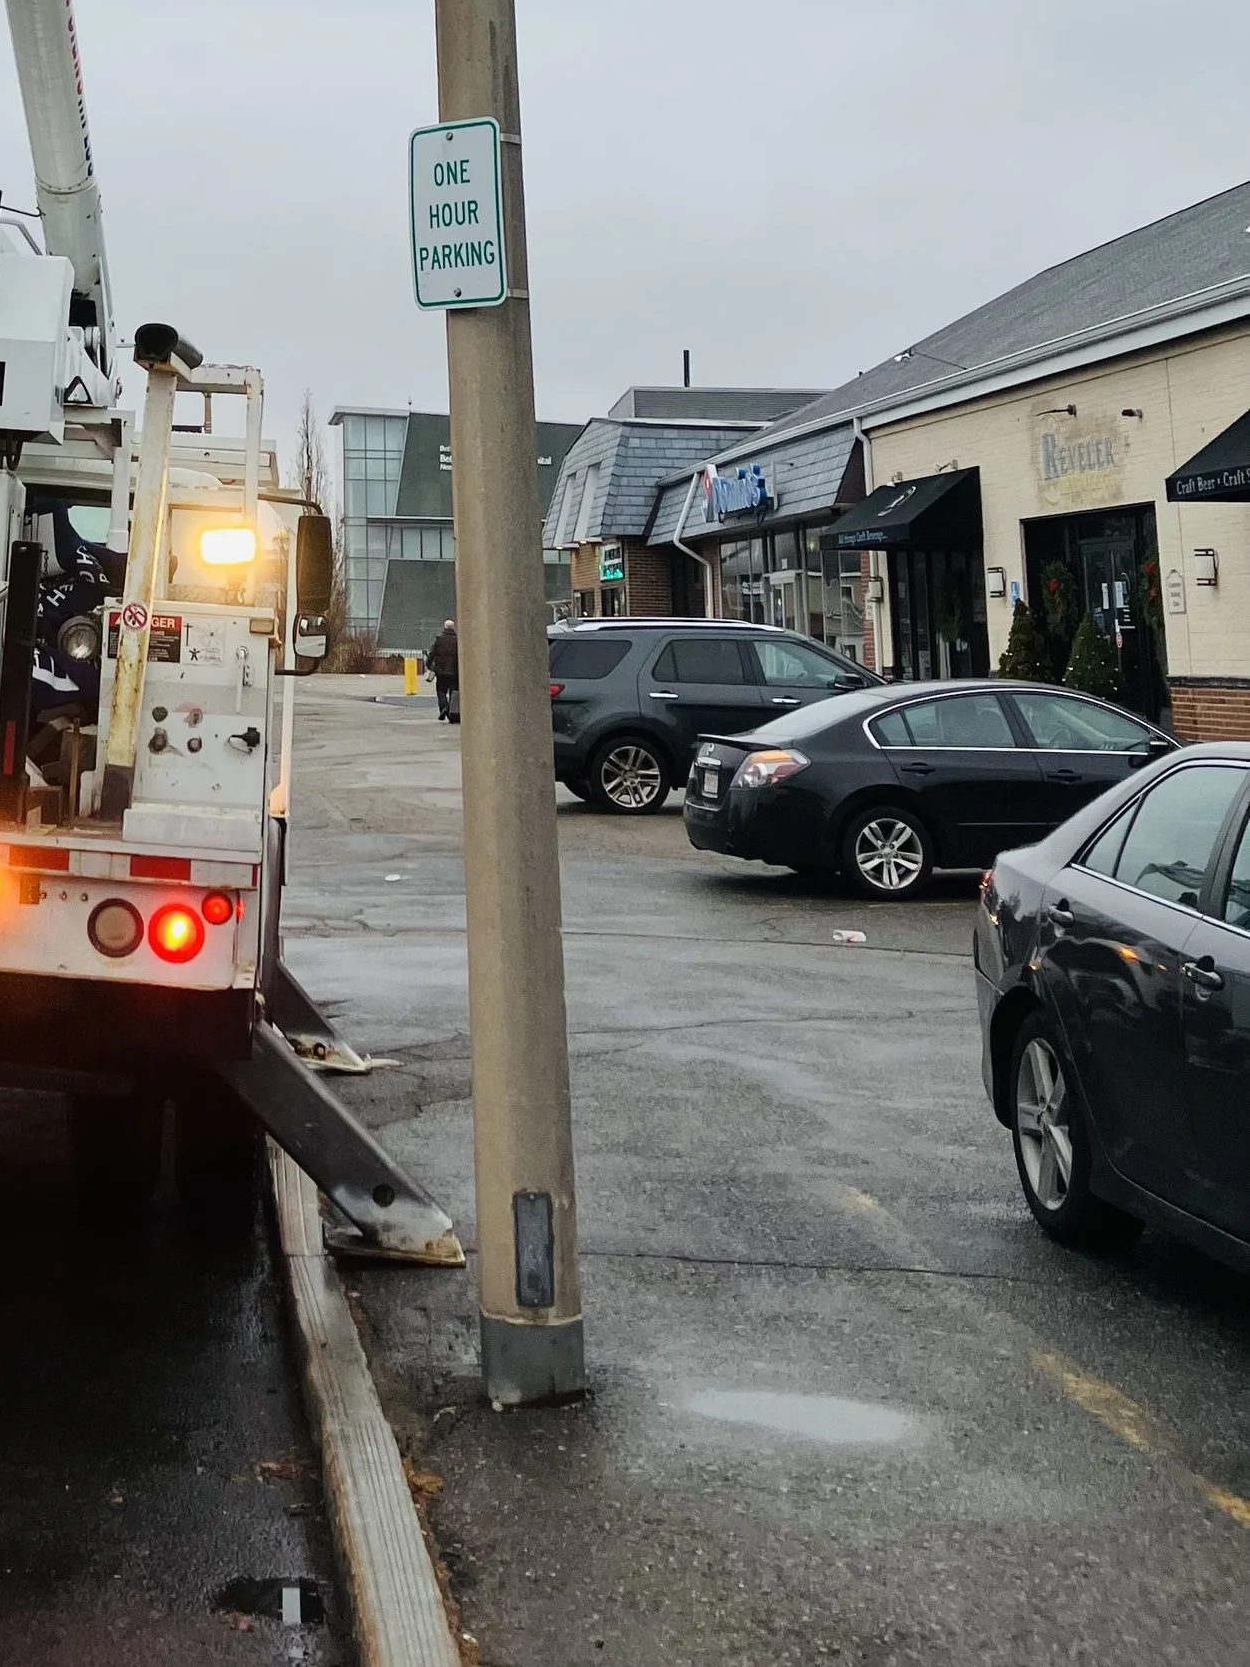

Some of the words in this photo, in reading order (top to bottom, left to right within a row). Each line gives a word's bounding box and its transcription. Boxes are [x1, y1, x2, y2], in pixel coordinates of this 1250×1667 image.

[434, 159, 470, 186] ONE
[429, 200, 479, 228] HOUR
[419, 240, 495, 271] PARKING
[1176, 478, 1196, 495] Craft
[1197, 477, 1215, 492] Beer
[1223, 470, 1246, 487] Craft
[151, 617, 175, 629] GER
